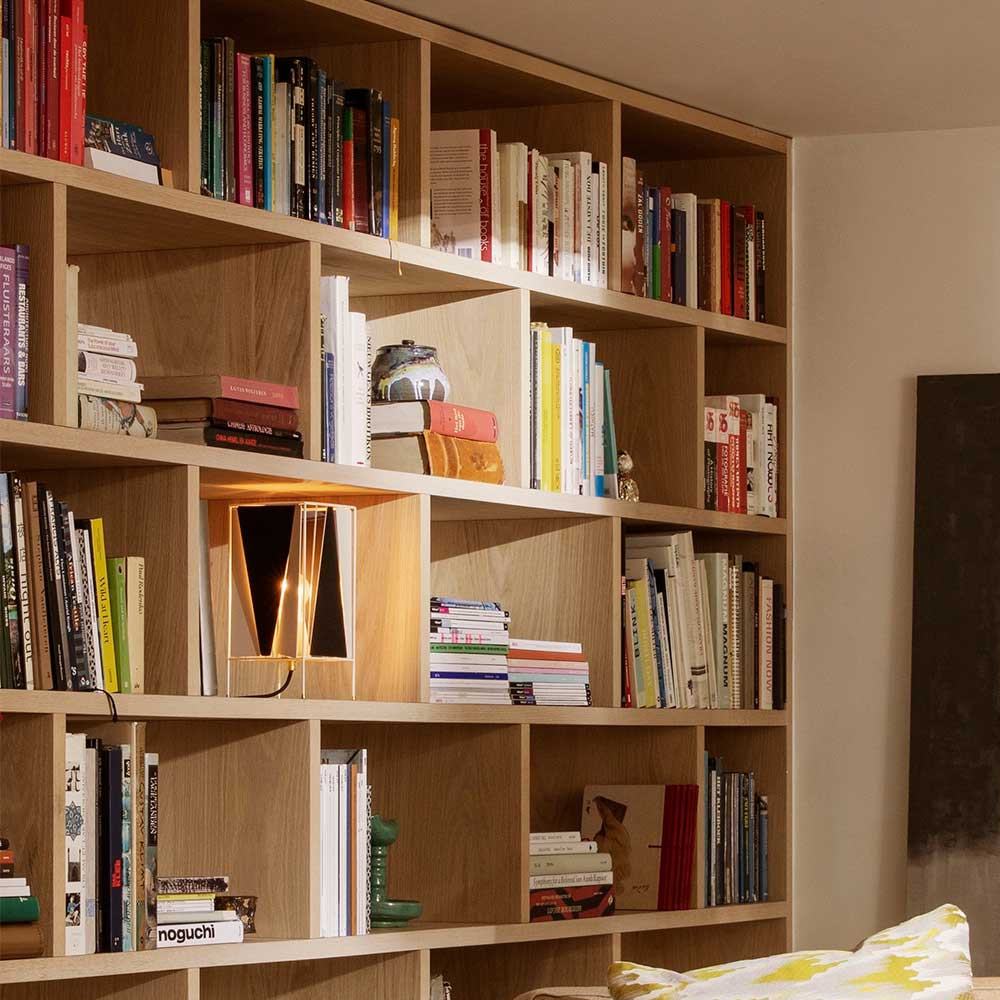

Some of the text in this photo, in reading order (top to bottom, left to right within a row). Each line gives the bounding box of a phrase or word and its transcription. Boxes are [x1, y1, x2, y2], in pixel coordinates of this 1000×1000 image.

[480, 143, 489, 252] the house of books
[2, 274, 11, 374] FLUISTERAARS
[17, 283, 26, 386] RESTAURANTS & BARS
[67, 553, 80, 632] African Textiles
[98, 576, 110, 644] Wild at Heart
[721, 558, 729, 622] MAGNUM
[630, 605, 641, 658] BLINK
[158, 924, 215, 943] noguchi
